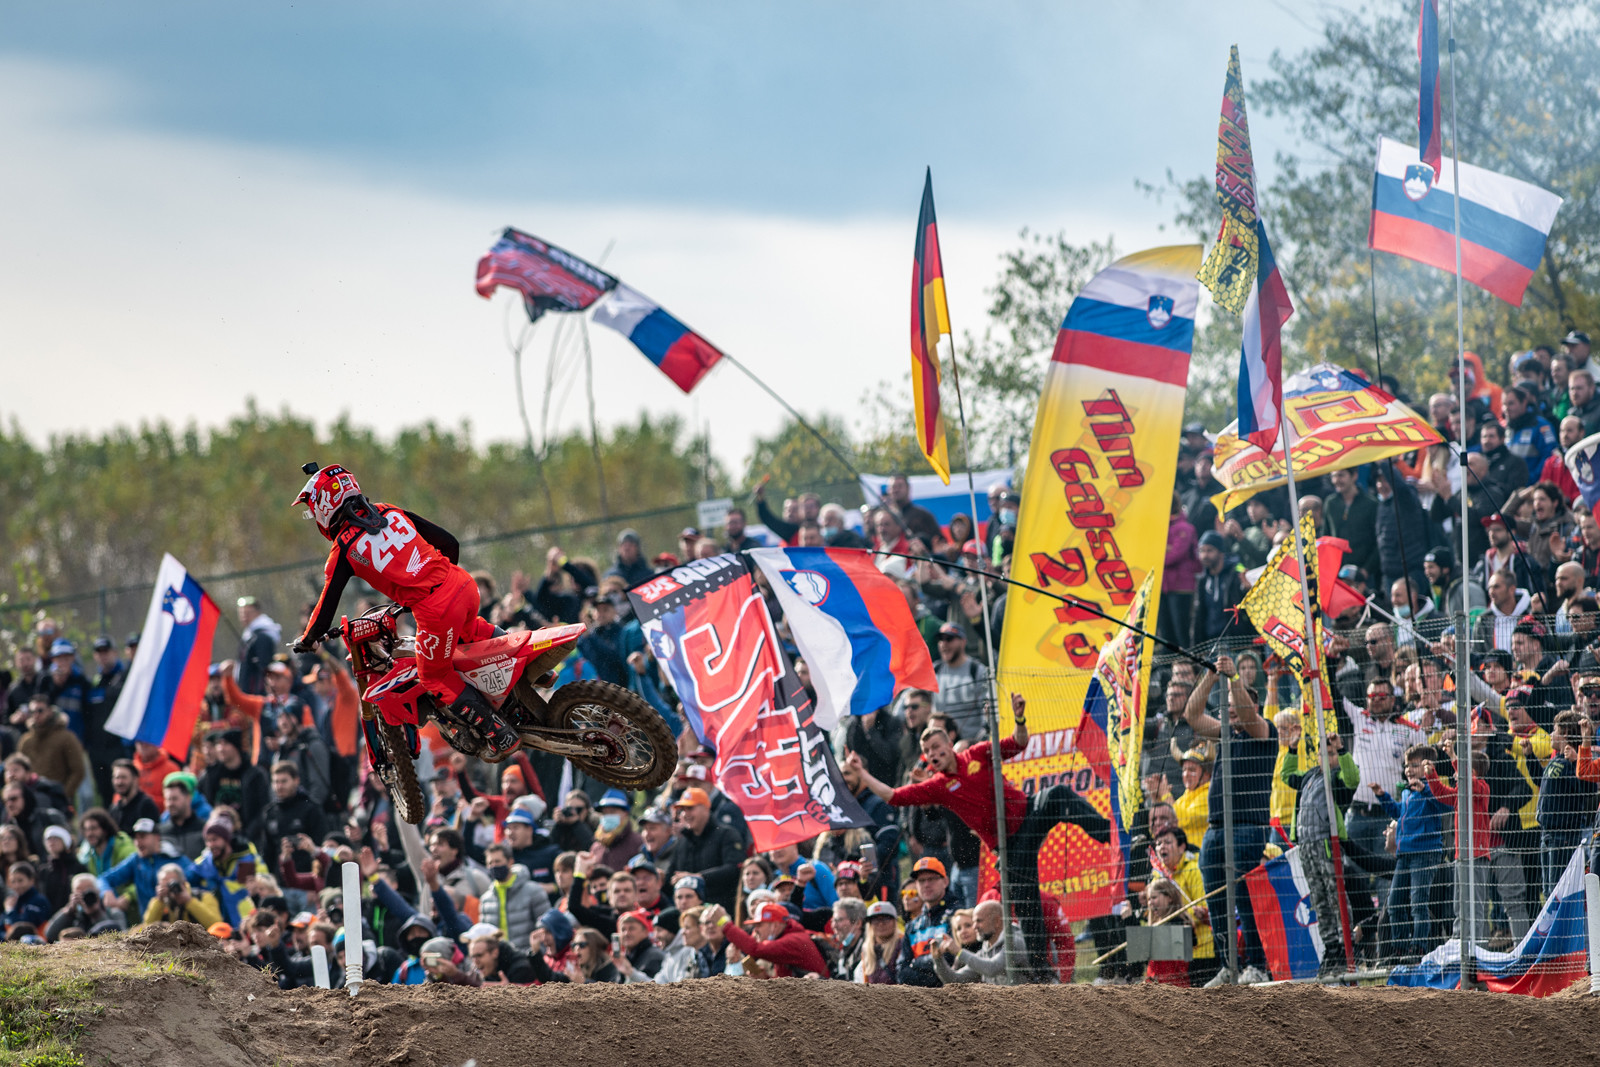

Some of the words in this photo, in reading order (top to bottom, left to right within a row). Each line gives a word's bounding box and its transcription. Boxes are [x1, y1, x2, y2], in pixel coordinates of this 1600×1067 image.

[1082, 388, 1146, 488] Tim
[356, 511, 417, 574] 243
[412, 556, 433, 577] HONDA
[444, 627, 454, 659] HONDA
[480, 653, 510, 666] HONDA
[480, 669, 508, 694] 243
